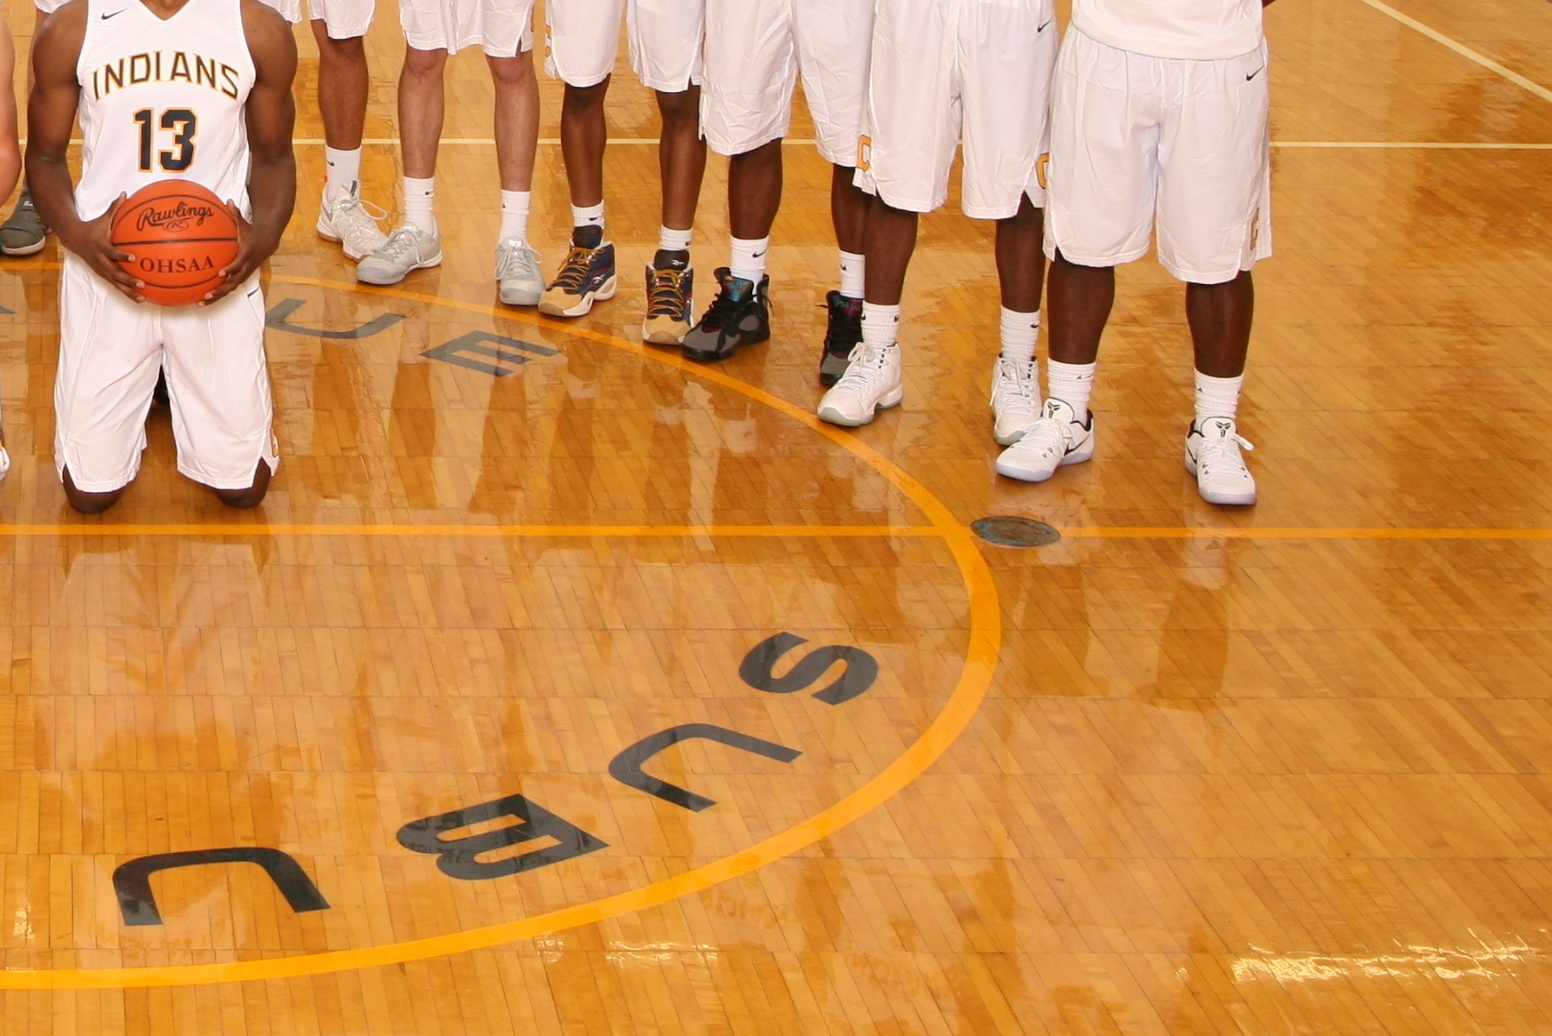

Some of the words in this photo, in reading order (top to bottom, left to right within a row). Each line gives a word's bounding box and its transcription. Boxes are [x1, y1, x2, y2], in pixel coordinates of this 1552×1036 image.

[91, 50, 242, 104] INDIANS
[131, 106, 200, 174] 13
[136, 200, 214, 232] Rawlings
[139, 255, 215, 274] OHSAA
